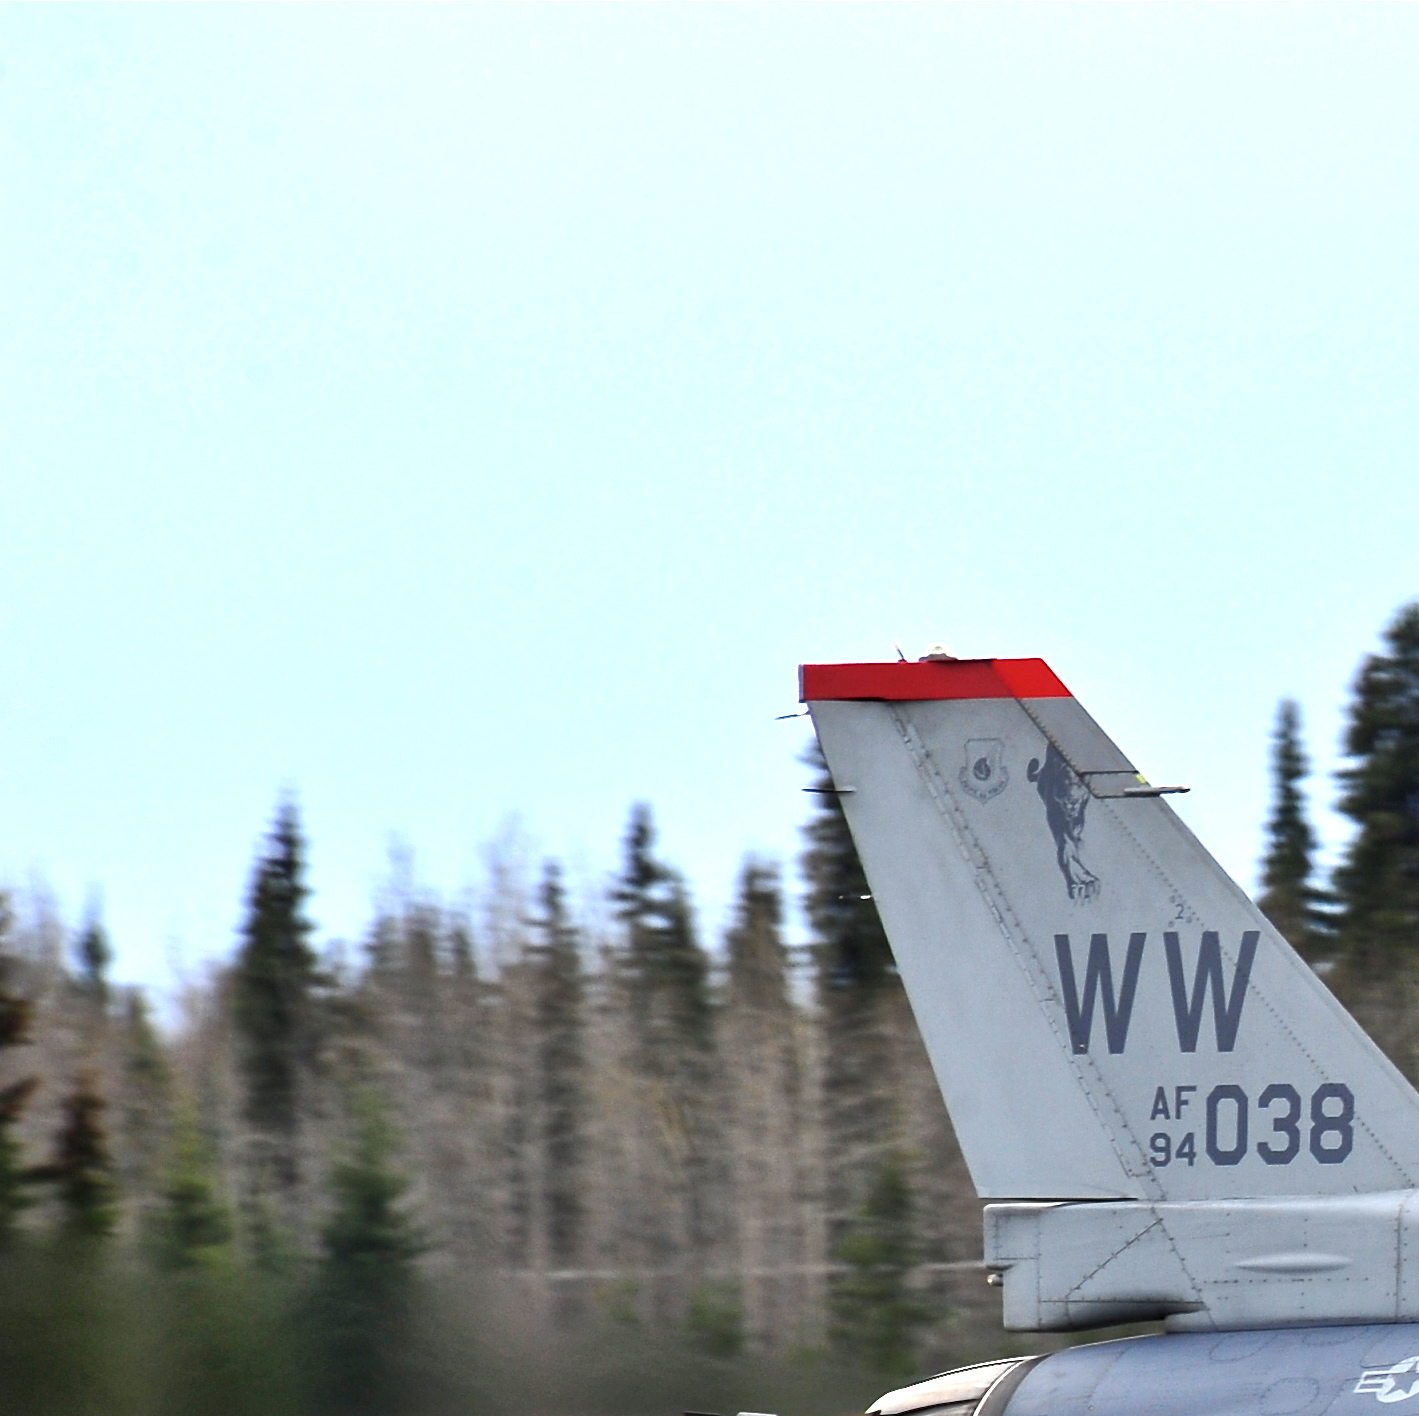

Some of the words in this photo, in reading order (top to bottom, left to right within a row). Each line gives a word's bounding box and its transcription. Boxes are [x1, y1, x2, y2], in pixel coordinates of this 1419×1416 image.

[1174, 903, 1185, 920] 2
[1054, 931, 1260, 1054] WW
[1150, 1085, 1197, 1120] AF
[1150, 1132, 1196, 1167] 94
[1206, 1083, 1354, 1165] 038
